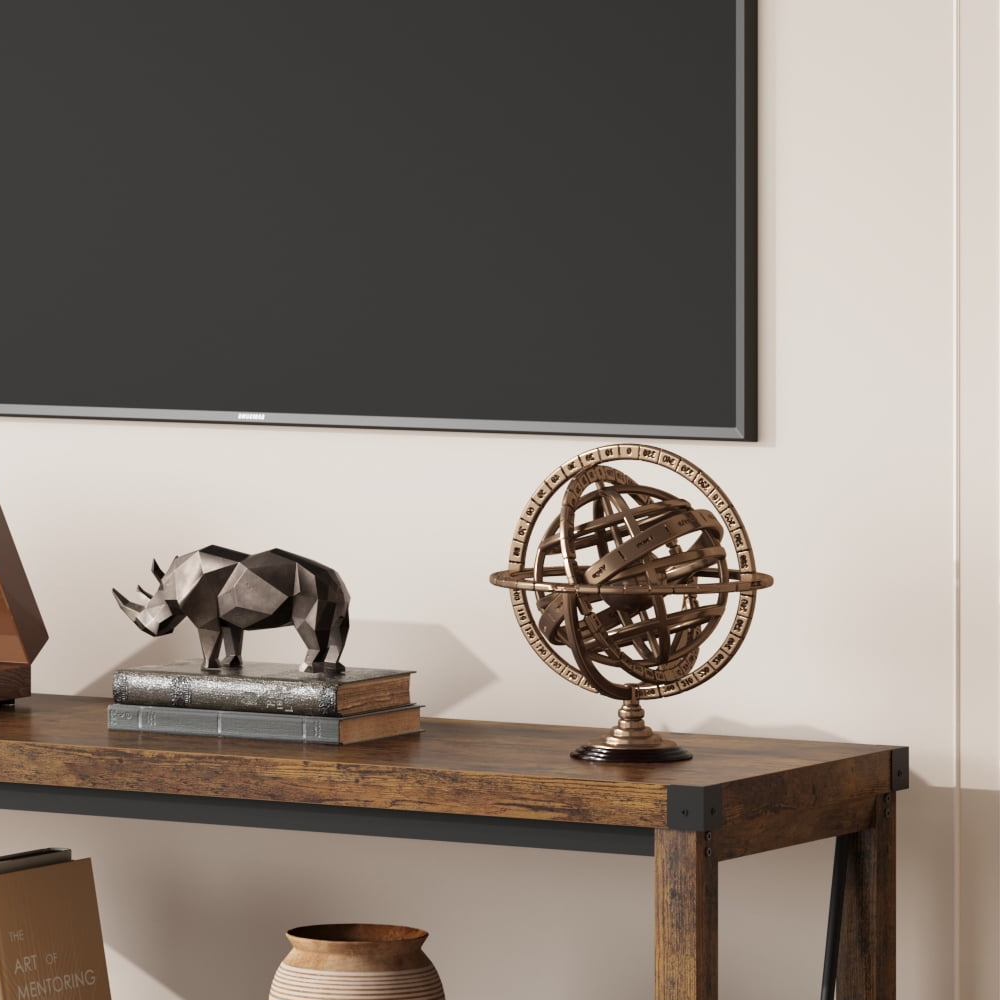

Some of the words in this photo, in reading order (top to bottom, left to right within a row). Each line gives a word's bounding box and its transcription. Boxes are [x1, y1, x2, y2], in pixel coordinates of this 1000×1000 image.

[8, 929, 24, 942] THE
[14, 954, 37, 975] ART
[46, 952, 59, 965] OF
[17, 969, 96, 1000] MENTORING
